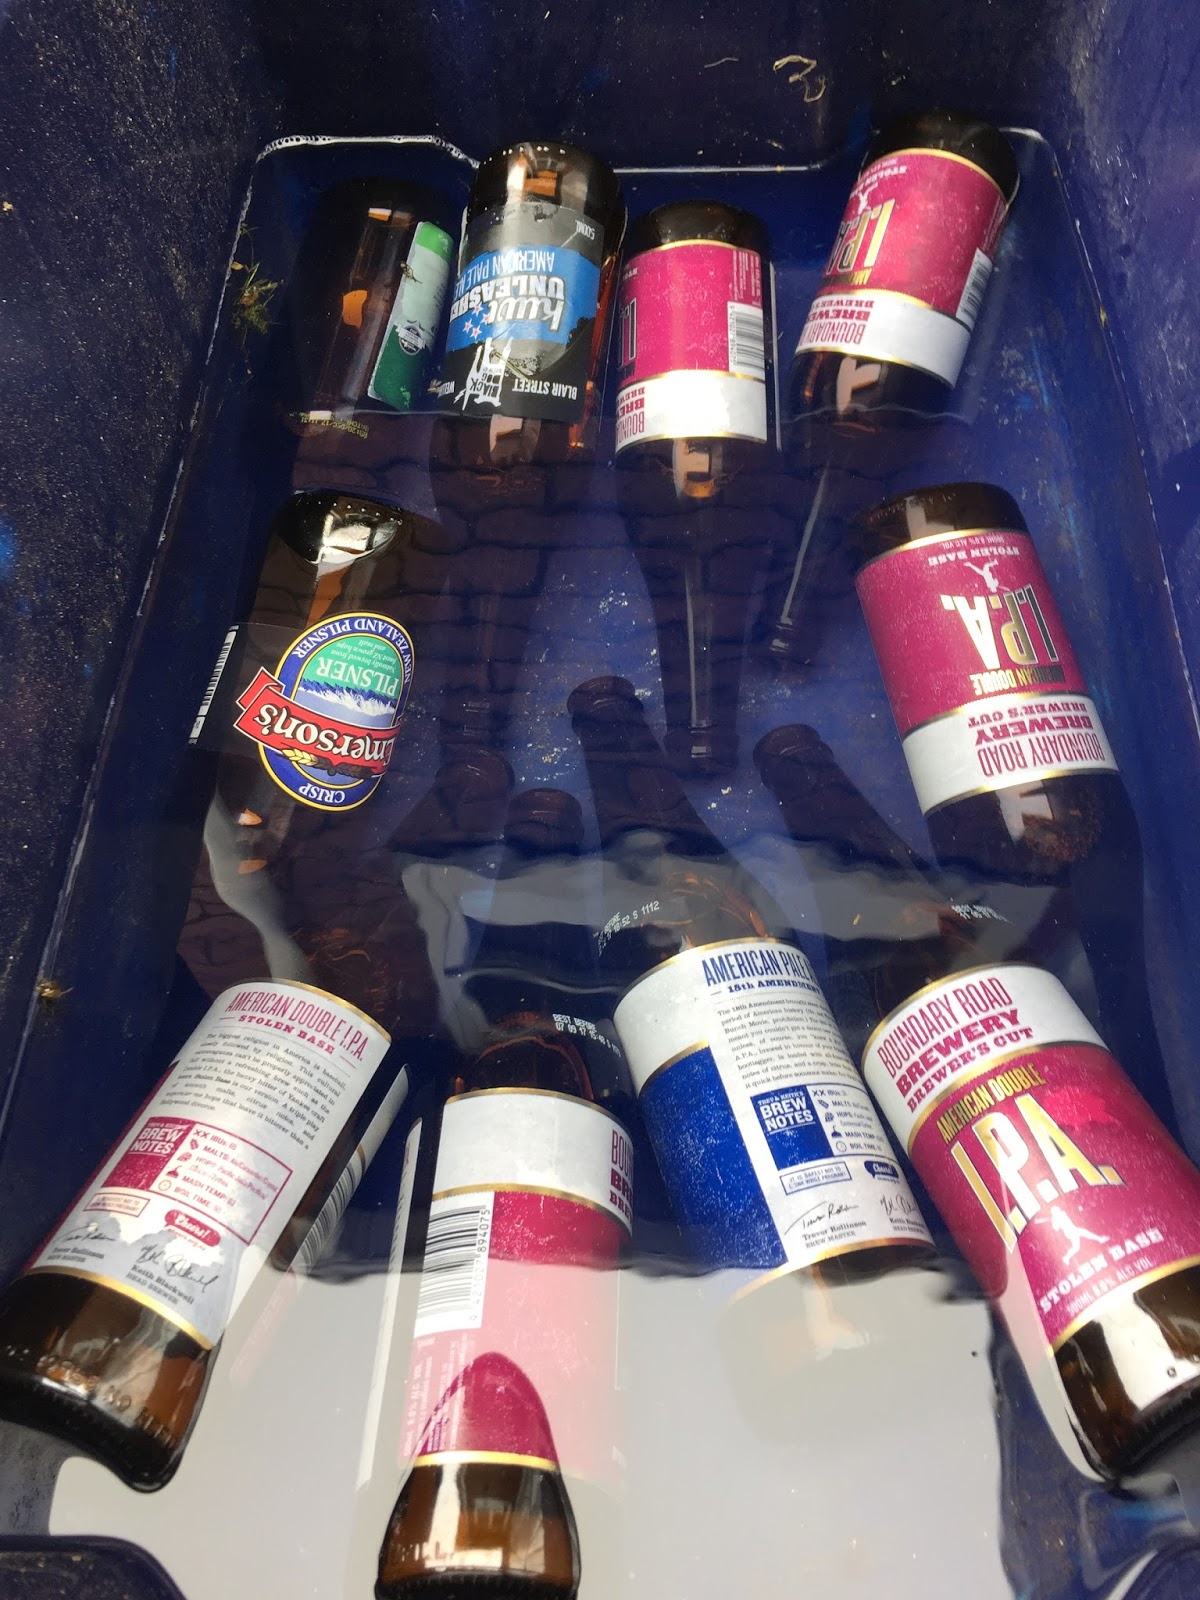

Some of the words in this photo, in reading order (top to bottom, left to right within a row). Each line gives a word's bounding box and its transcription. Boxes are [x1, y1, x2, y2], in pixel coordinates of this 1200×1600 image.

[467, 259, 489, 290] PALE
[492, 249, 555, 276] AMERICAN
[470, 378, 499, 398] BLACK
[481, 373, 501, 385] DOG
[512, 378, 550, 395] STREET
[551, 382, 577, 400] BLAIR
[928, 551, 968, 566] BASE
[970, 546, 1020, 558] STOLEN
[291, 619, 351, 658] PILSNER
[354, 618, 409, 654] ZEALAND
[940, 583, 1059, 670] I.P.A.
[316, 656, 399, 697] PILSNER
[403, 654, 412, 683] NEW
[968, 711, 1004, 728] CUT
[1007, 702, 1087, 719] BREWER'S
[252, 703, 396, 767] Emerson's
[975, 715, 1093, 746] BREWERY
[977, 740, 1028, 777] ROAD
[1028, 732, 1105, 767] BOUNDARY
[298, 782, 346, 803] CRISP
[641, 900, 660, 915] 1112
[702, 950, 783, 987] AMERICAN
[727, 982, 755, 993] 18th
[225, 992, 295, 1018] AMERICAN
[289, 1000, 346, 1041] DOUBLE
[340, 1025, 368, 1061] I.P.A.
[552, 1013, 571, 1024] BEST
[721, 1015, 743, 1026] period
[752, 1007, 783, 1017] American
[877, 994, 960, 1079] BOUNDARY
[952, 977, 1013, 1018] ROAD
[239, 1014, 294, 1033] STOLEN
[298, 1030, 335, 1054] BASE
[243, 1036, 269, 1046] religion
[273, 1043, 280, 1051] in
[284, 1048, 311, 1065] America
[896, 1008, 1020, 1098] BREWERY
[253, 1047, 262, 1055] by
[300, 1066, 313, 1078] This
[317, 1078, 340, 1098] cultural
[261, 1060, 291, 1077] properly
[292, 1074, 328, 1100] appreciated
[328, 1098, 335, 1107] in
[907, 1042, 991, 1114] BREWER'S
[993, 1027, 1033, 1048] CUT
[235, 1062, 271, 1077] refreshing
[273, 1074, 291, 1087] brew
[321, 1104, 330, 1114] the
[258, 1081, 278, 1091] hitter
[288, 1093, 310, 1111] Yankee
[311, 1110, 325, 1123] craft
[246, 1097, 268, 1110] citrus
[302, 1130, 316, 1141] and
[289, 1106, 307, 1121] triple
[306, 1120, 320, 1132] play
[760, 1097, 807, 1119] BREW
[936, 1084, 996, 1147] AMERICAN
[987, 1062, 1048, 1103] DOUBLE
[138, 1127, 184, 1142] BREW
[222, 1098, 237, 1107] that
[238, 1105, 256, 1115] leave
[290, 1132, 304, 1146] than
[764, 1109, 814, 1131] NOTES
[131, 1140, 174, 1154] NOTES
[203, 1145, 229, 1161] MALTS:
[181, 1175, 204, 1189] MASH
[950, 1092, 1125, 1256] I.P.A.
[477, 1209, 490, 1253] 894075
[802, 1228, 828, 1241] Trevor
[830, 1221, 867, 1234] Rollinson
[805, 1239, 826, 1249] BREW
[828, 1231, 856, 1243] MASTER
[126, 1273, 147, 1287] HEAD
[131, 1264, 155, 1280] Keith
[155, 1276, 195, 1304] Blackwell
[1039, 1252, 1108, 1315] STOLEN
[1108, 1227, 1165, 1262] BASE
